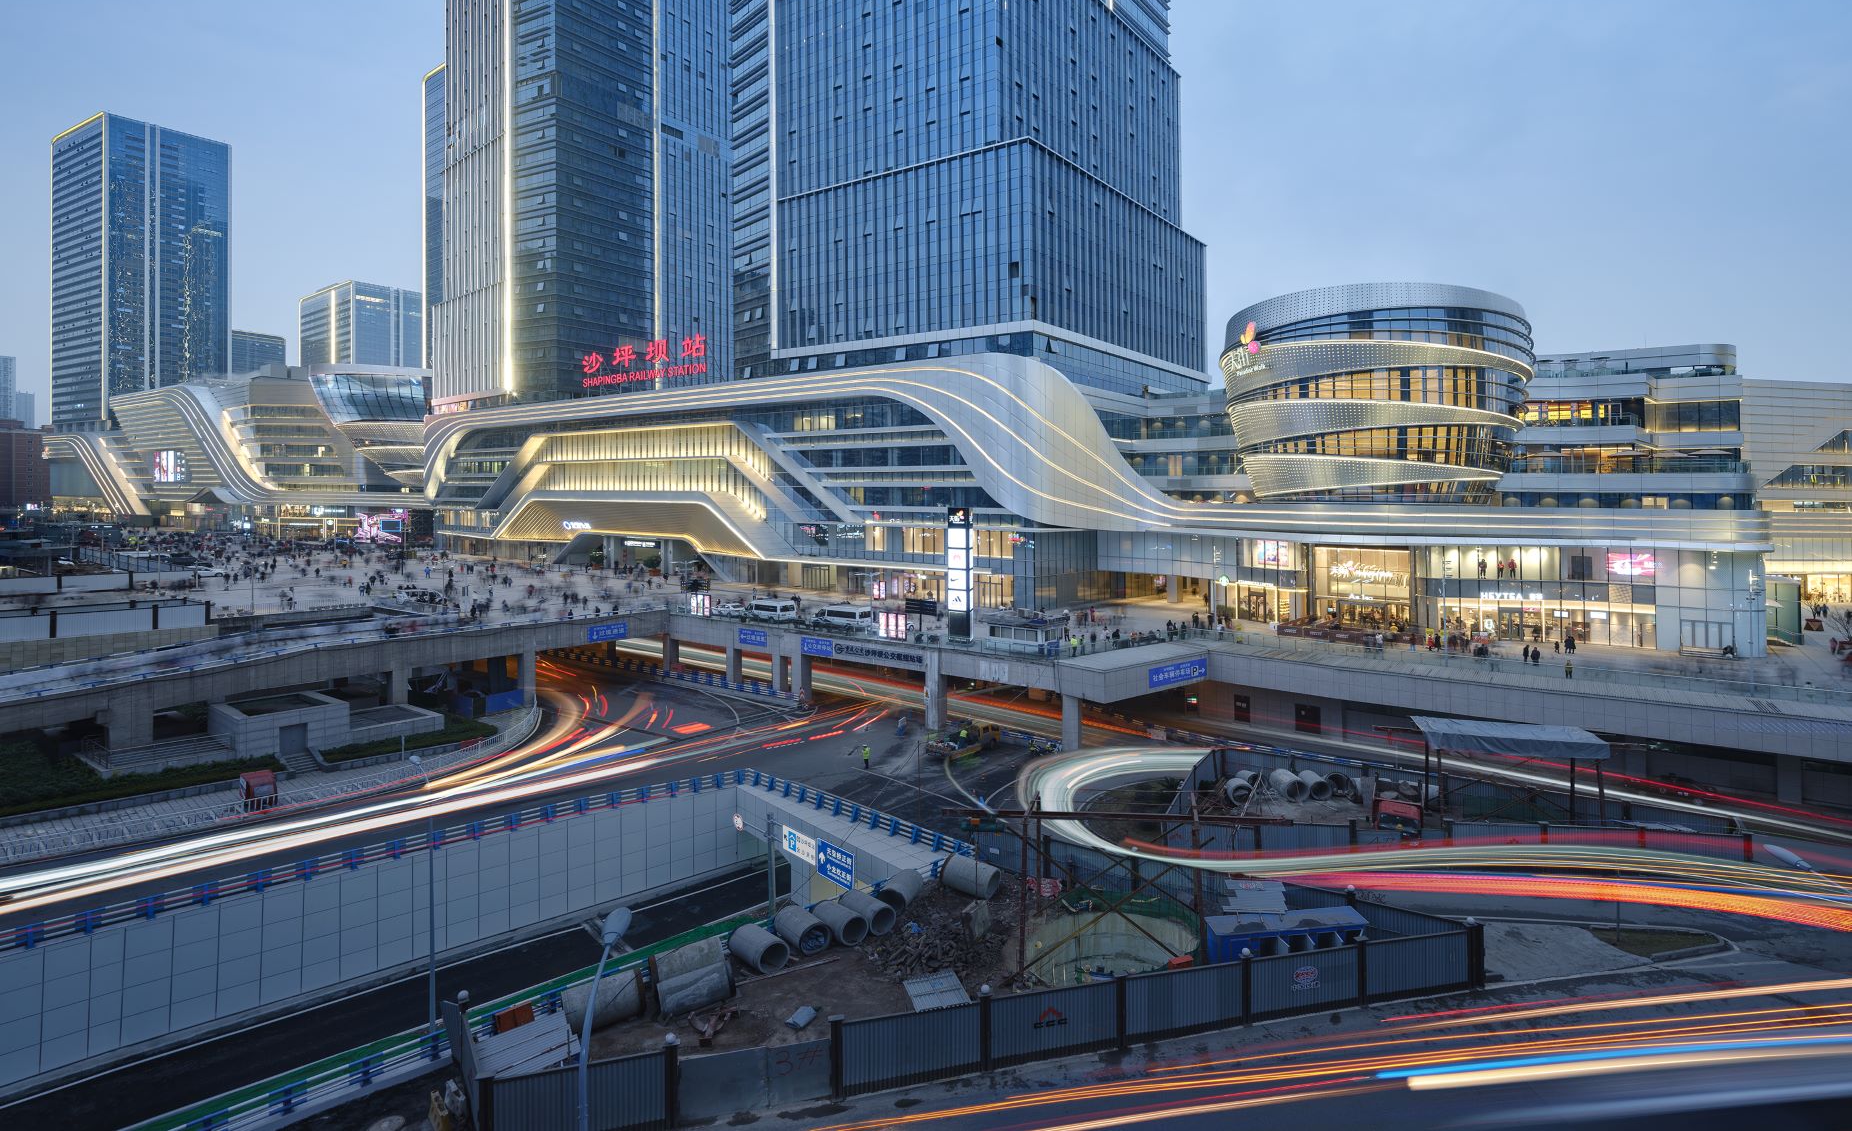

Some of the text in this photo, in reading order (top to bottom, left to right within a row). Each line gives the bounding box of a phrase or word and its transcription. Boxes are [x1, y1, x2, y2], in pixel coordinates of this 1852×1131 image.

[582, 333, 706, 374] 沙坪坝站
[582, 363, 707, 388] SHAPINGBA RAILWAY STATION
[1480, 591, 1523, 600] HEYTEA
